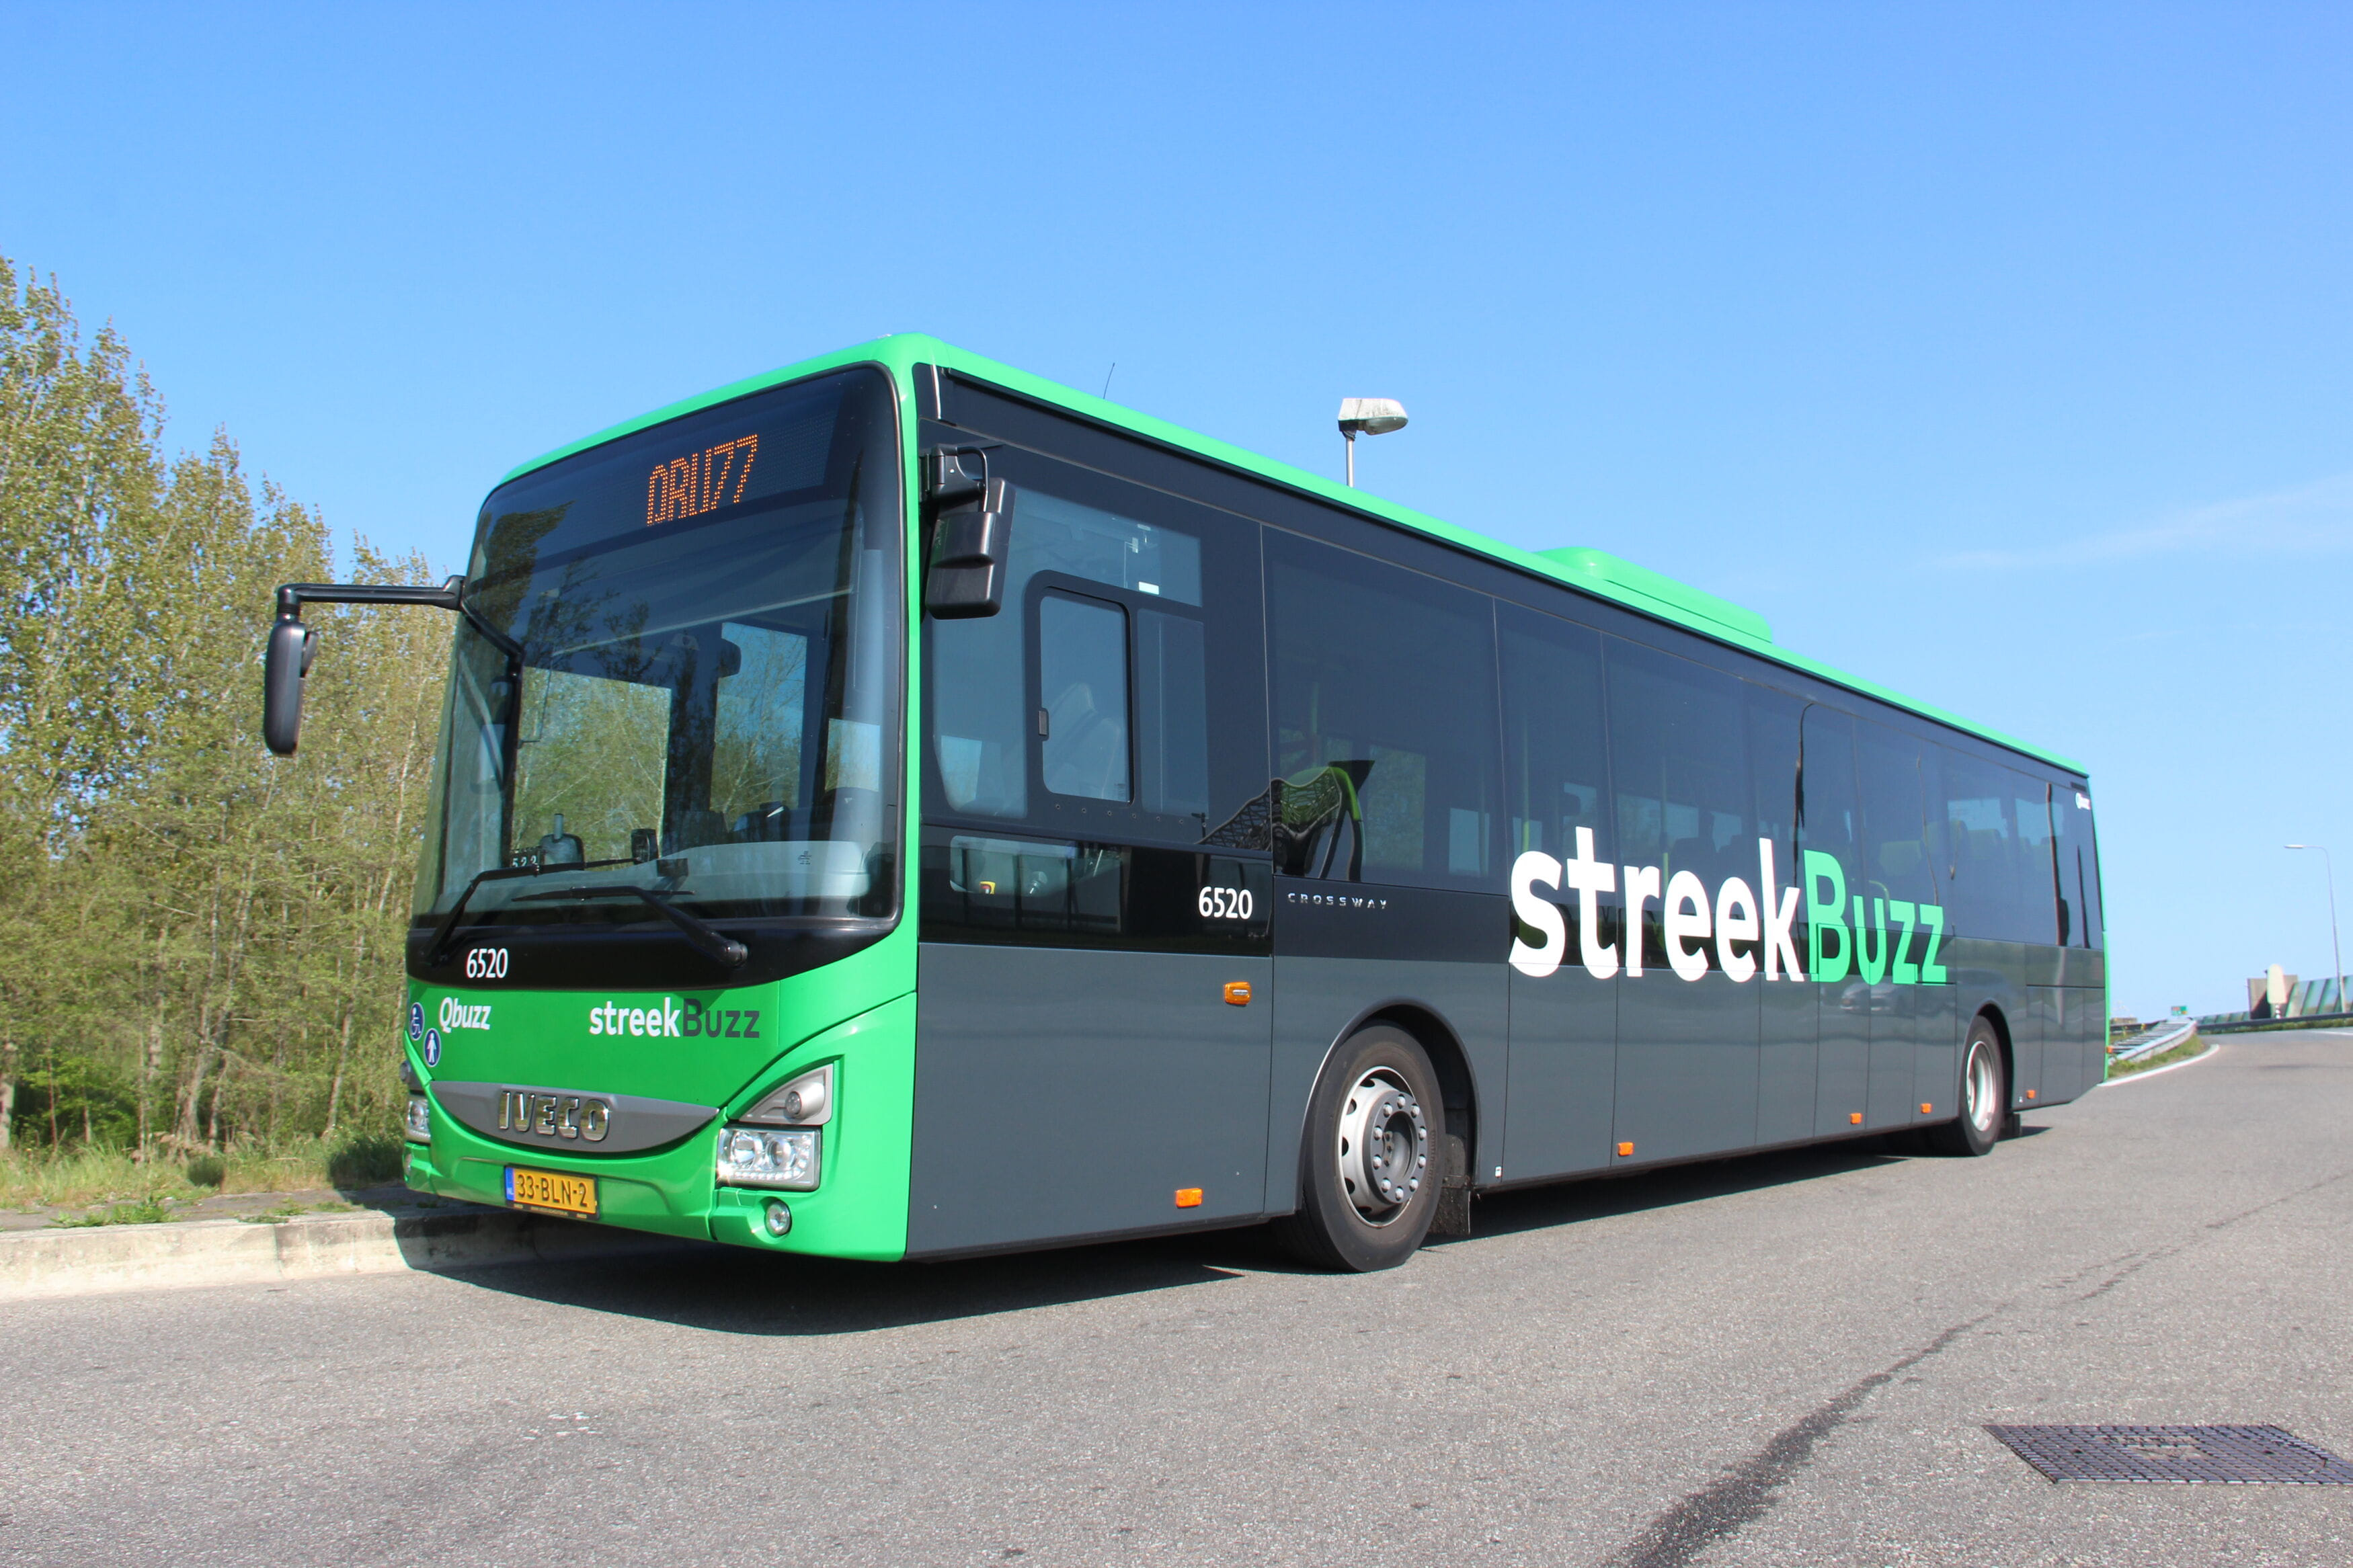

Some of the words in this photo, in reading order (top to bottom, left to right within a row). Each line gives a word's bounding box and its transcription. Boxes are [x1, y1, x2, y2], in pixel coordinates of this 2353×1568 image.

[1199, 886, 1252, 919] 6520
[1287, 893, 1387, 909] CROSSWAY
[1509, 826, 1947, 986] streekBuzz
[466, 948, 508, 979] 6520
[440, 997, 492, 1033] Qbuzz
[589, 997, 760, 1038] streekBuzz
[499, 1091, 610, 1141] IVECO
[517, 1173, 588, 1208] 33-BLN-2
